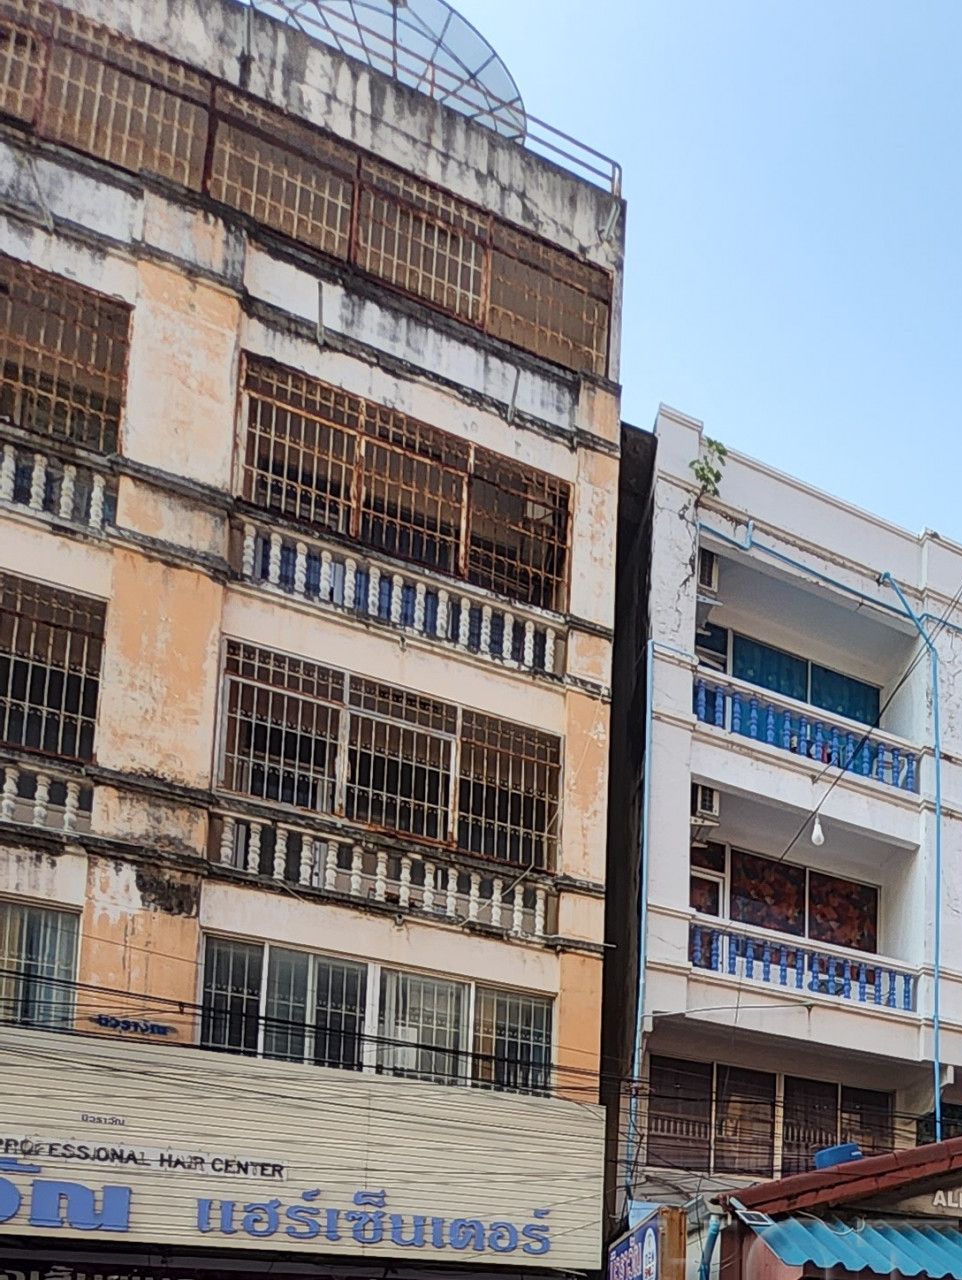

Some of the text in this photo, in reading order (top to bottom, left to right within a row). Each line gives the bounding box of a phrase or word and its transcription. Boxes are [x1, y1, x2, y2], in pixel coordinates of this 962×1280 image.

[0, 1138, 285, 1178] ROFESSIONAL HAIR CENTER
[196, 1188, 552, 1255] แฮร์เซ็นเตอร์
